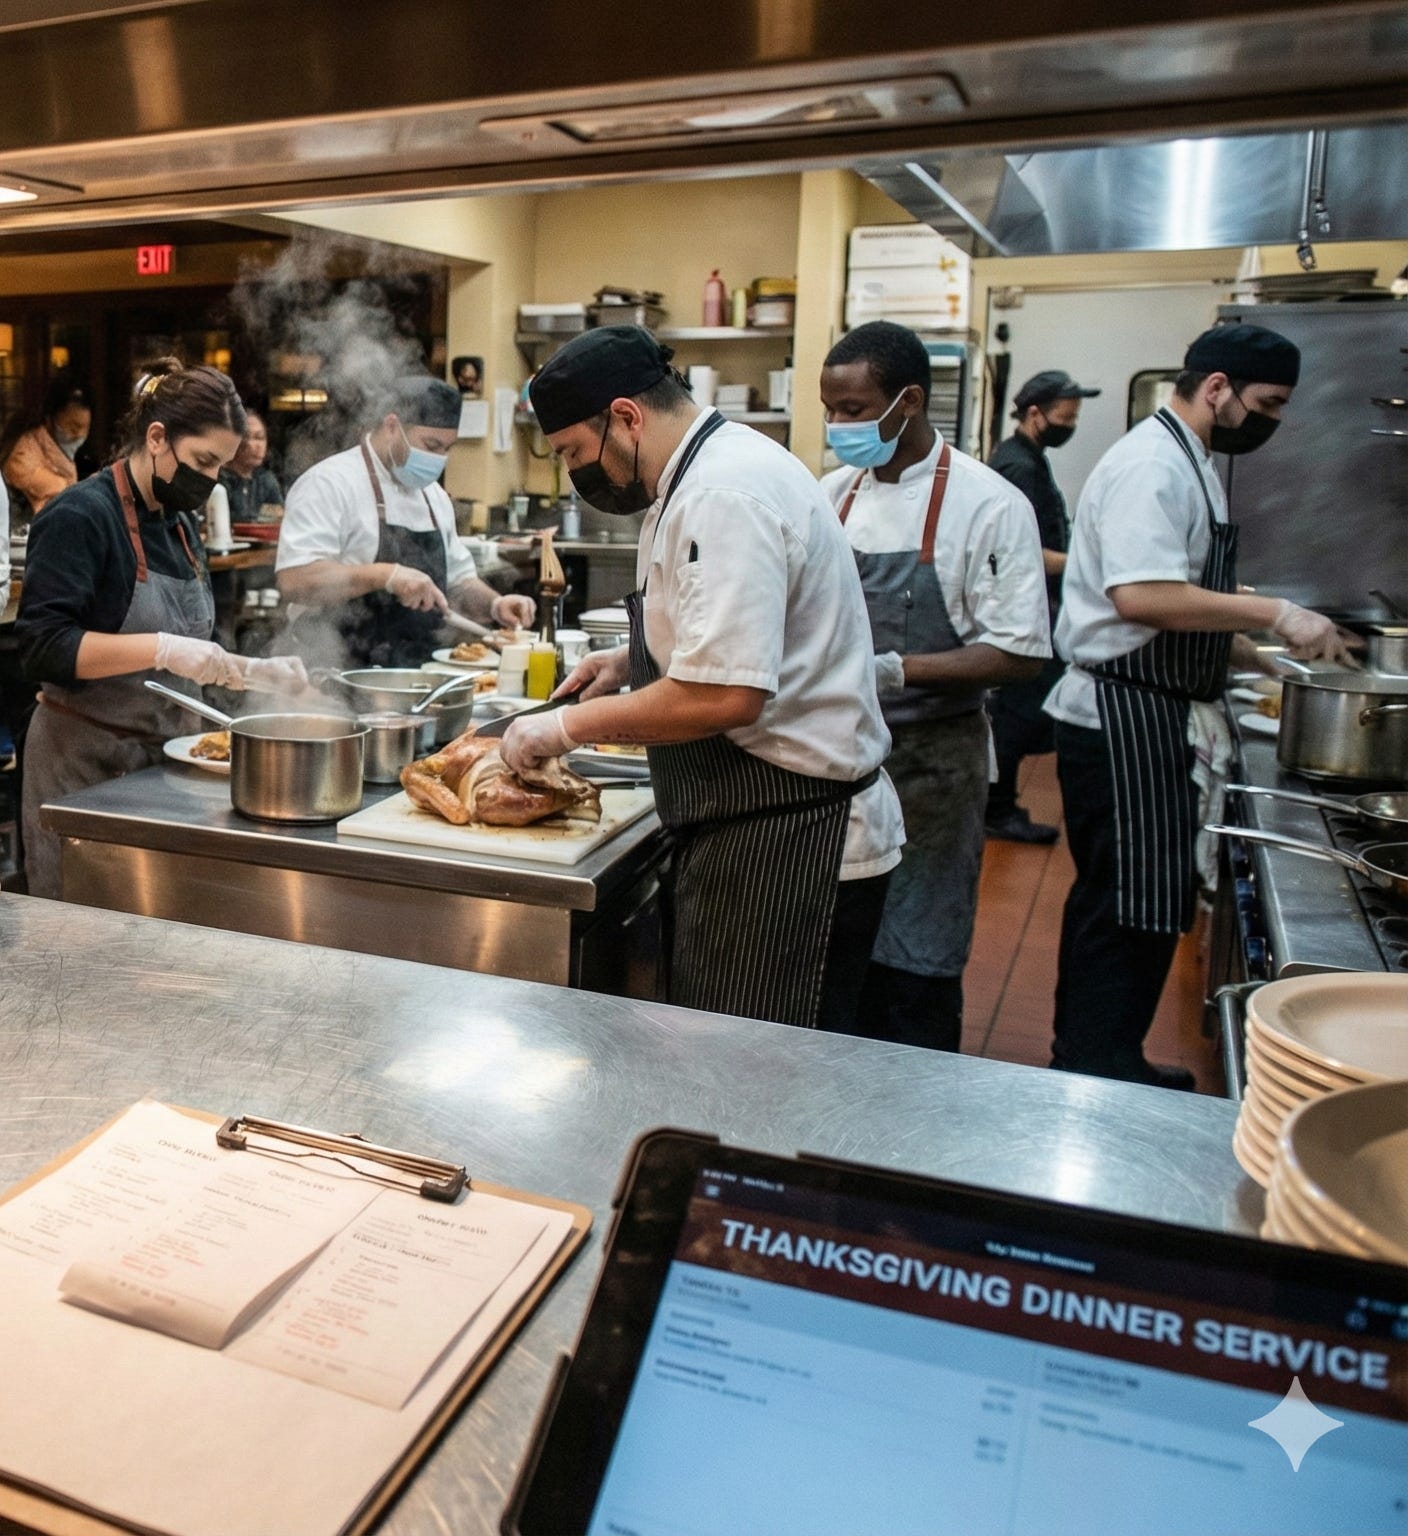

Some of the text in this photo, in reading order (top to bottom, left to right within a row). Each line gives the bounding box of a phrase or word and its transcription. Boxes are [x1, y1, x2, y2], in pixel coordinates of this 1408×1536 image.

[136, 245, 173, 275] EXIT
[721, 1218, 1012, 1308] THANKSGIVING
[1021, 1282, 1183, 1346] DINNER
[1193, 1318, 1389, 1390] SERVICE
